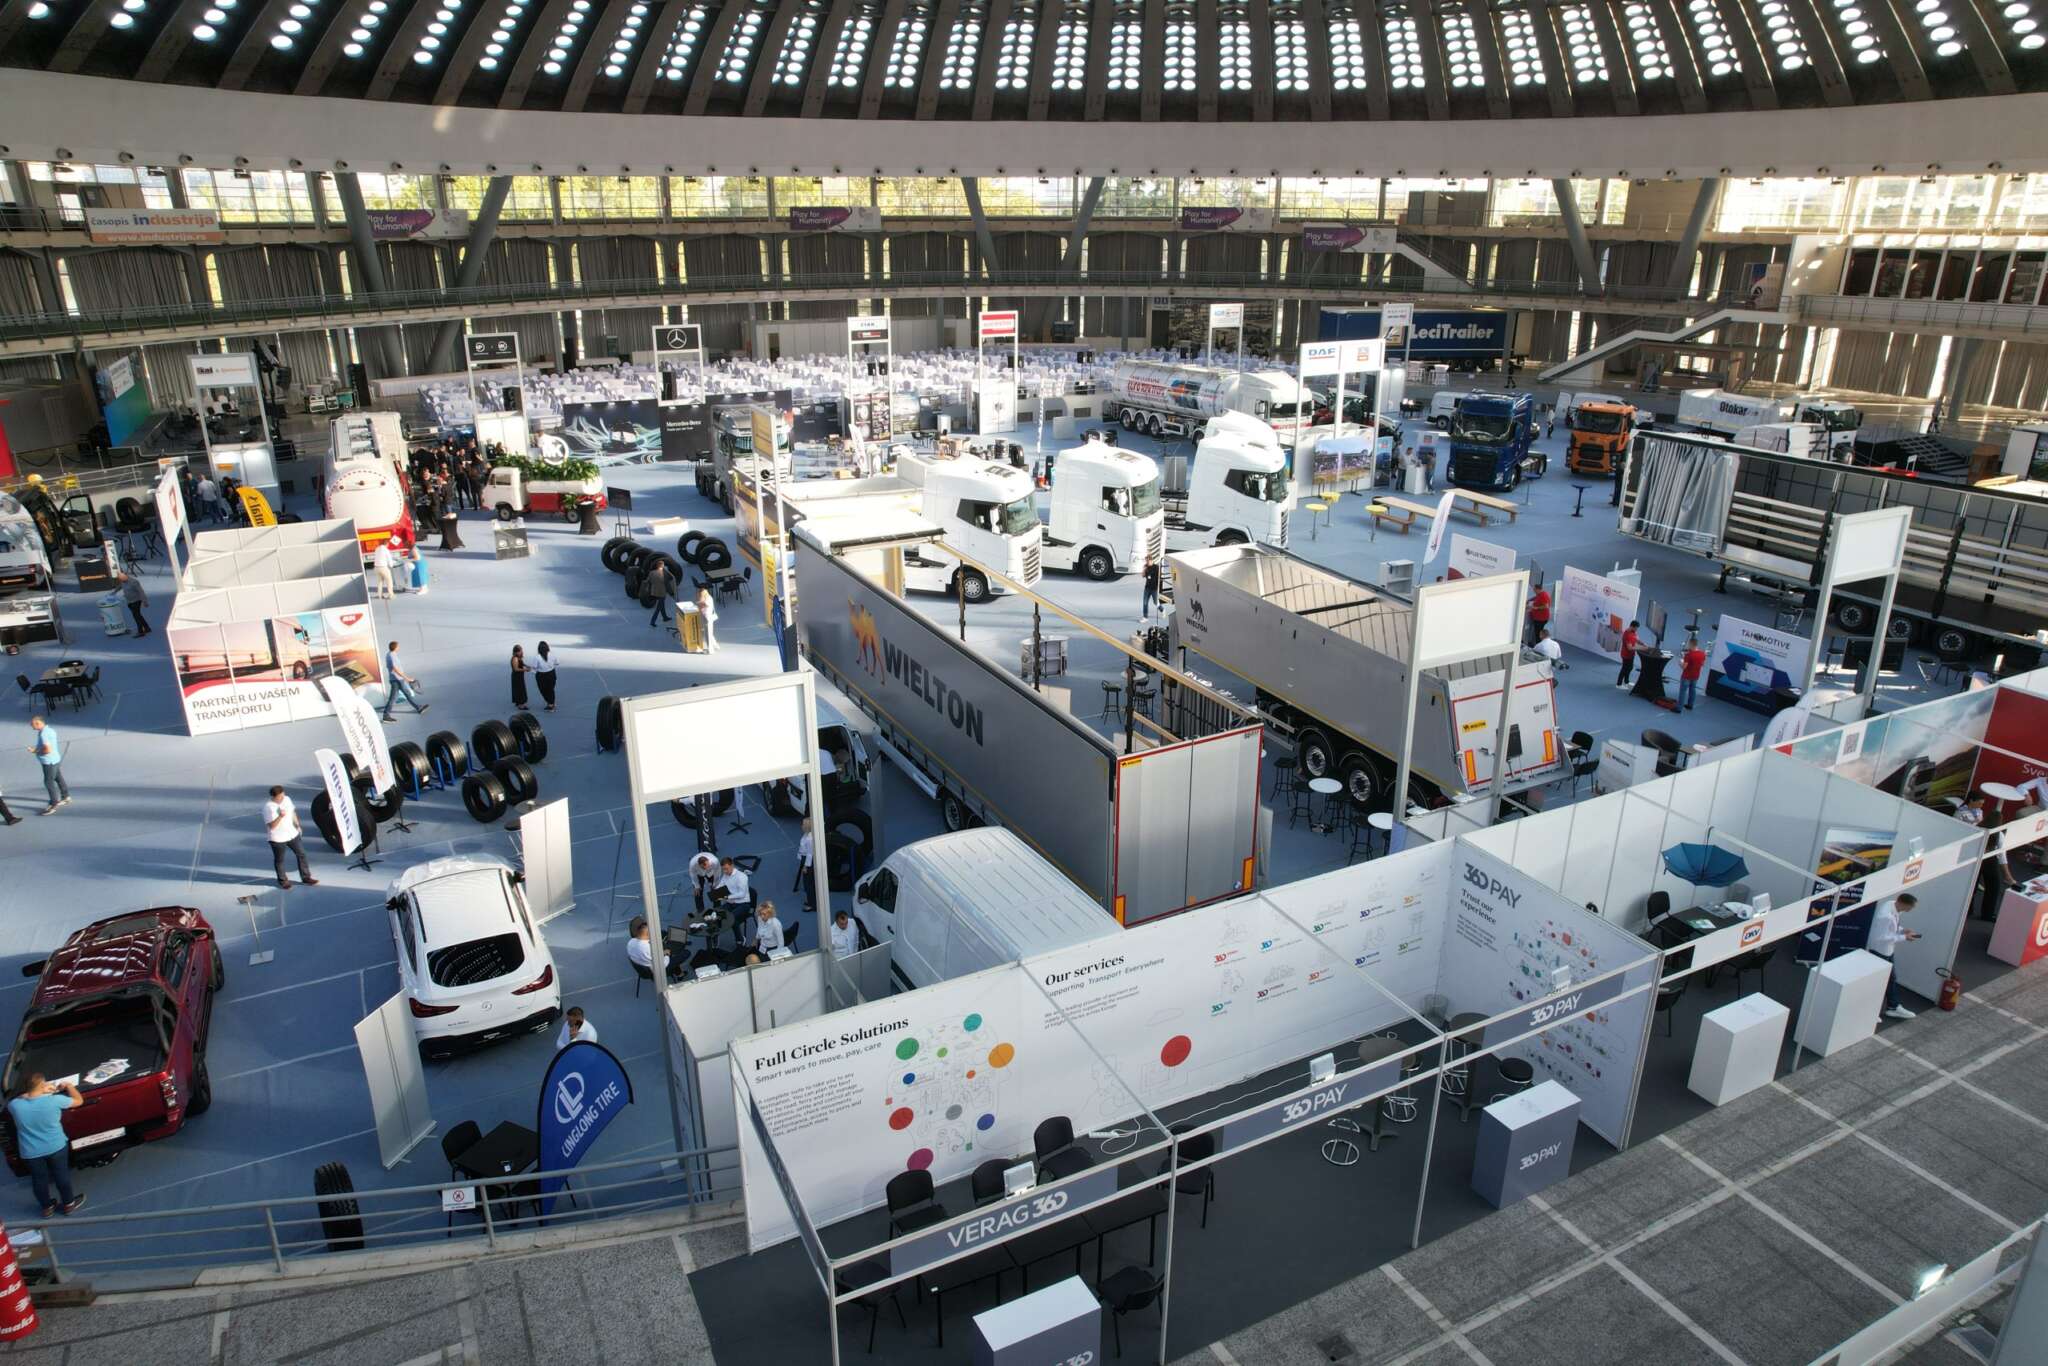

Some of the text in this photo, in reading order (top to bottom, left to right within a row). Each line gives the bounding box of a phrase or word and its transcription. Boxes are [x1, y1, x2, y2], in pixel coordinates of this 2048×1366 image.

[133, 213, 215, 228] industrija
[1184, 210, 1198, 219] Play
[1190, 217, 1222, 225] Humanity
[374, 223, 413, 232] Humanity
[1306, 232, 1320, 241] Play
[1411, 323, 1494, 340] LeciTrailer
[1720, 401, 1748, 416] Otokar
[192, 686, 300, 709] PARTNER U VAŠEM
[883, 637, 983, 748] WIELTON
[195, 703, 272, 721] TRANSPORTU
[1462, 888, 1494, 913] Trust our
[1490, 878, 1522, 909] PAY
[1460, 899, 1497, 925] experience
[1045, 955, 1125, 986] Our services
[1088, 970, 1122, 985] Transport
[1124, 957, 1165, 974] Everywhere
[1554, 992, 1583, 1017] PAY
[755, 1018, 909, 1071] Full Circle Solutions
[755, 1070, 782, 1084] Smart
[785, 1065, 806, 1076] ways
[808, 1060, 817, 1068] to
[819, 1052, 844, 1065] move,
[864, 1042, 882, 1052] care
[1282, 1083, 1348, 1123] 360 PAY
[561, 1081, 621, 1158] LINGLONG TIRE
[1539, 1141, 1561, 1162] PAY
[947, 1191, 1068, 1248] VERAG 360
